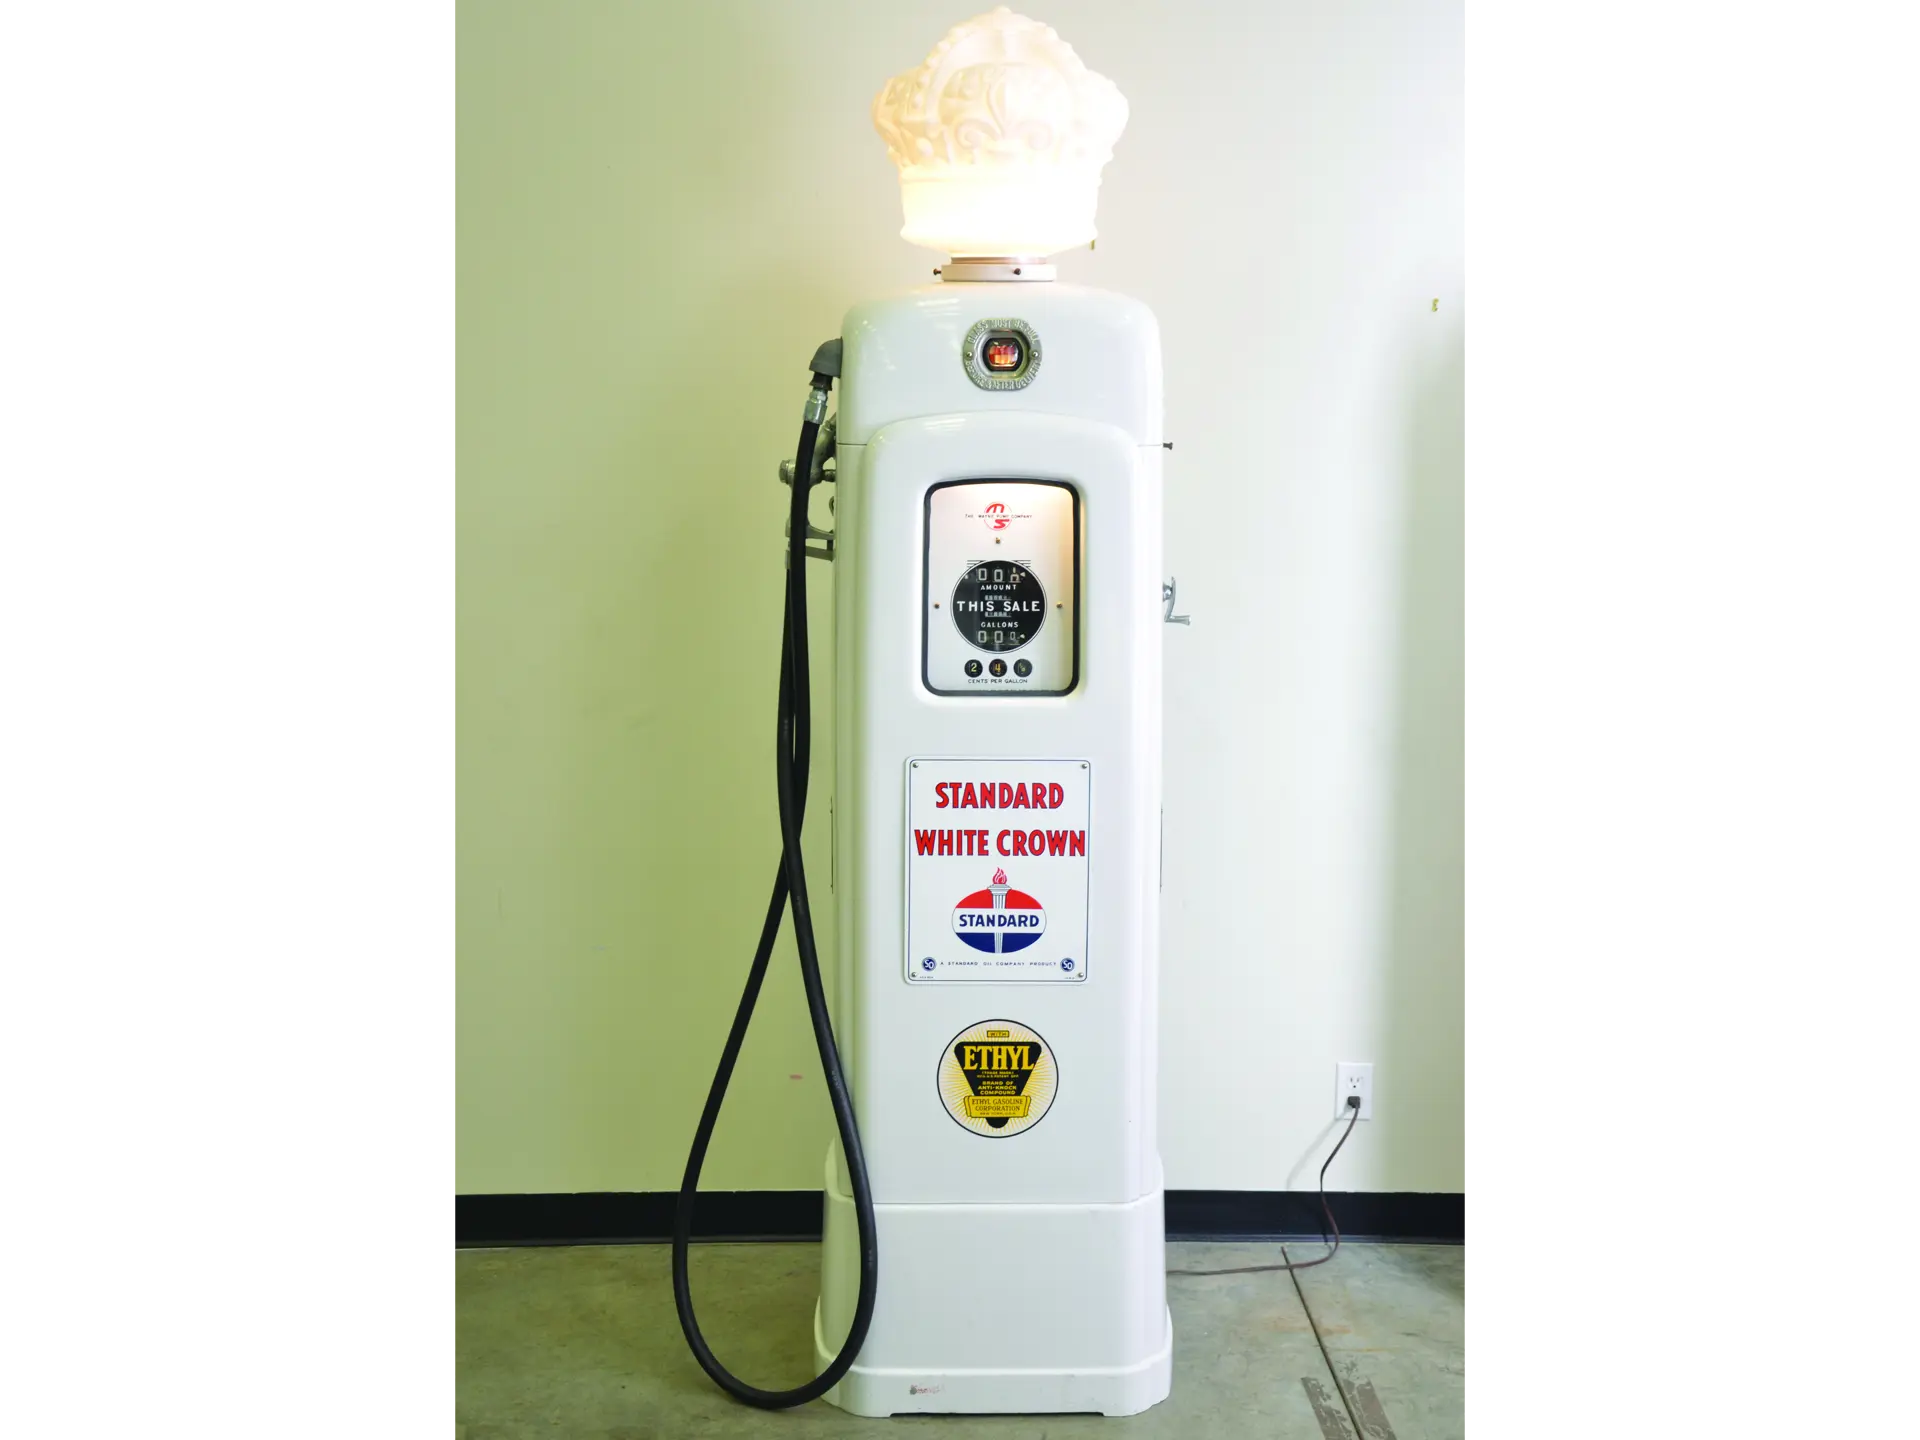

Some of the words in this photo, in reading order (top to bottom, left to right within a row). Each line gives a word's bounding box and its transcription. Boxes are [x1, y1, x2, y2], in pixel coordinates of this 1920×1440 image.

[957, 601, 994, 612] THIS
[1003, 601, 1040, 612] SALE
[971, 662, 977, 672] 2
[995, 663, 1001, 673] 4
[935, 782, 1064, 809] STANDARD
[914, 829, 989, 856] WHITE
[996, 829, 1086, 857] CROWN
[959, 914, 1040, 927] STANDARD
[963, 1045, 1035, 1071] ETHYL
